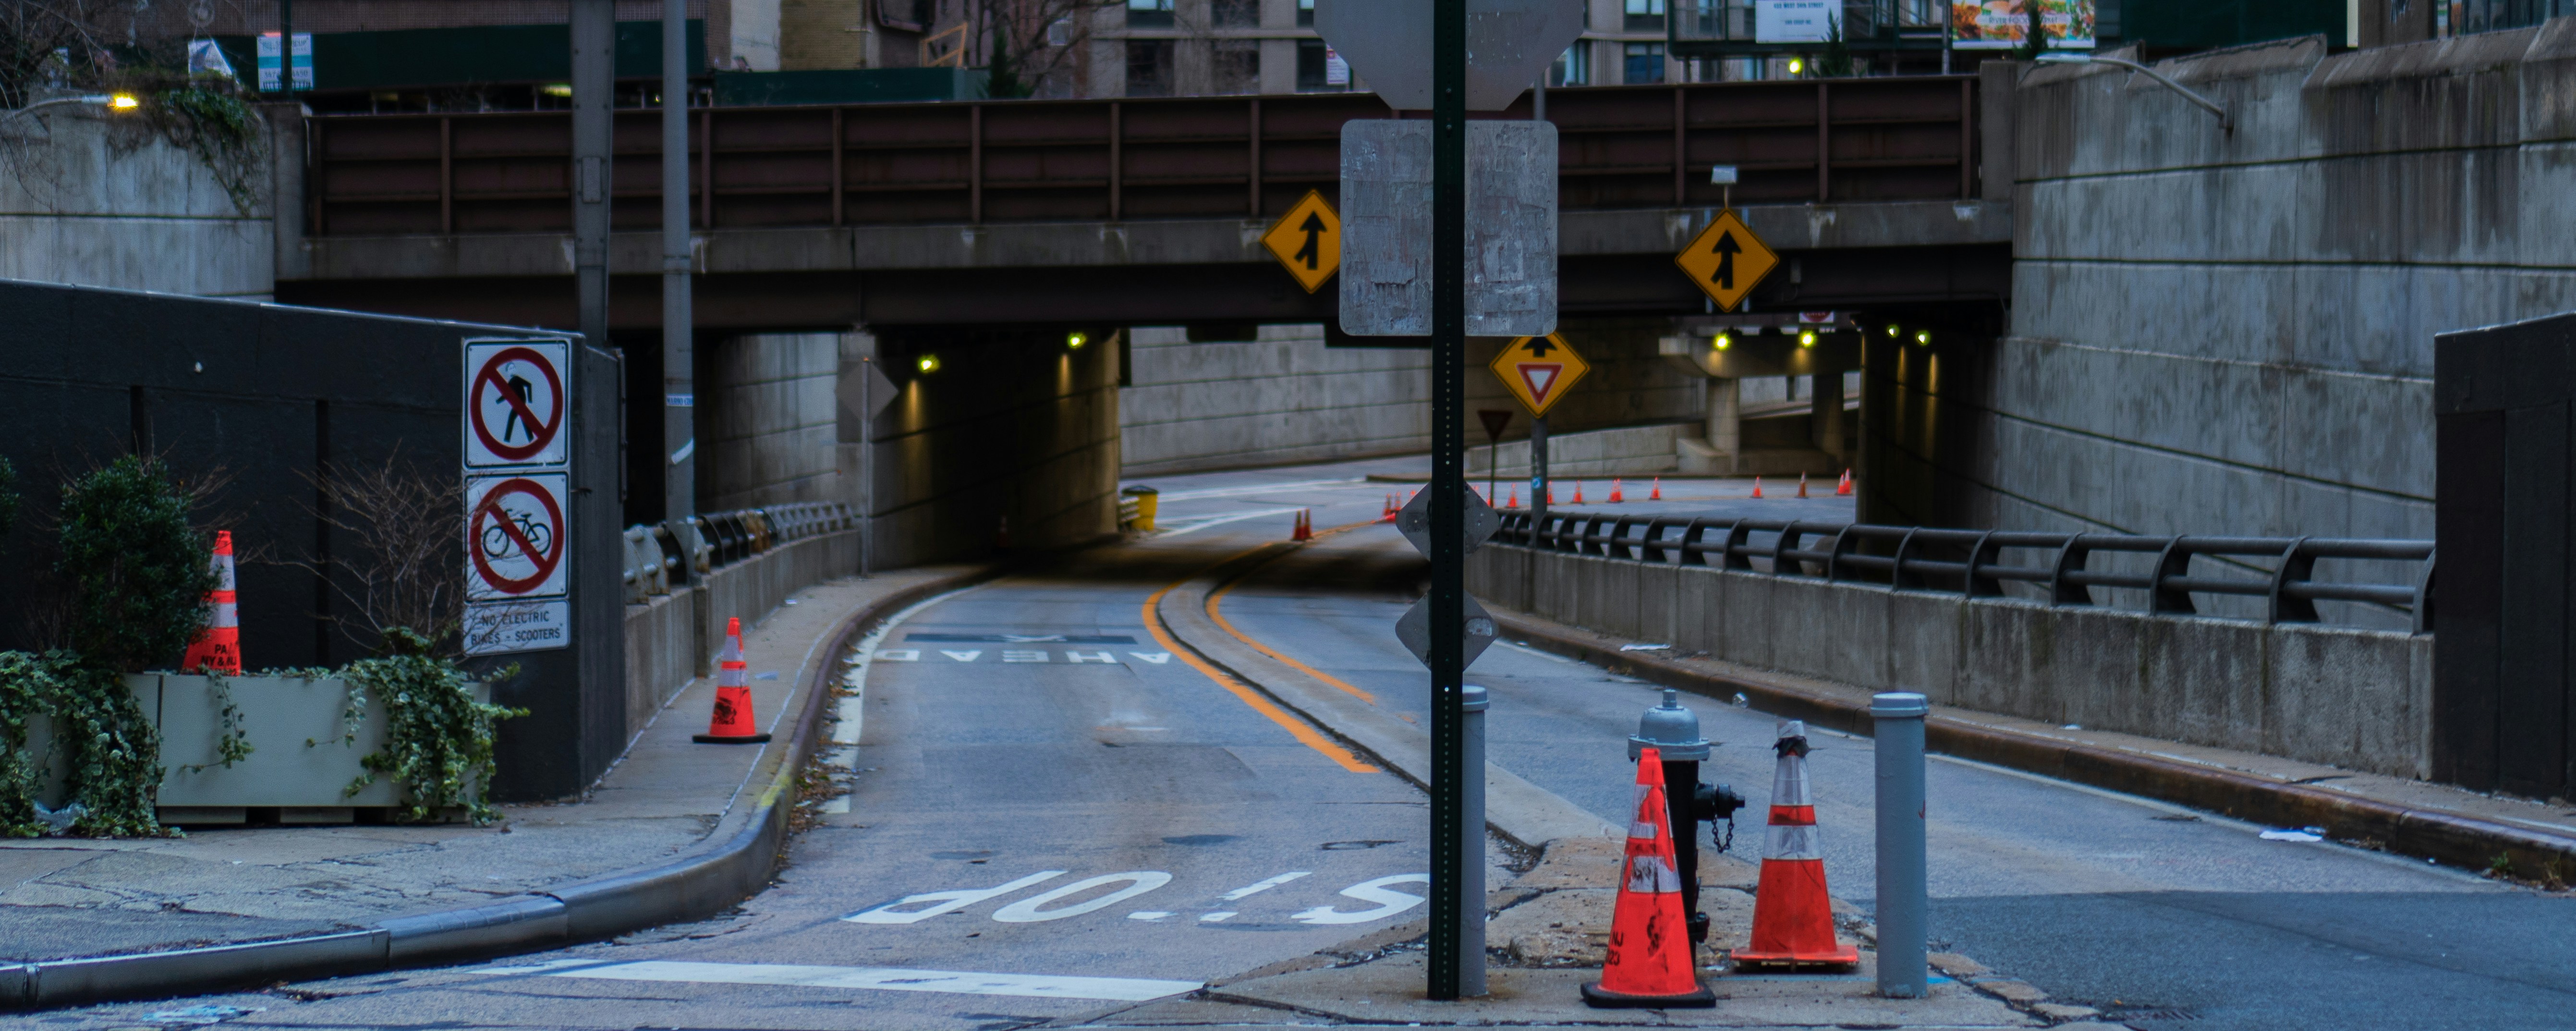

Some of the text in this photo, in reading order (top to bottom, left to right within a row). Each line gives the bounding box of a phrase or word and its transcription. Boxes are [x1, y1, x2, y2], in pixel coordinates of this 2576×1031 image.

[482, 610, 550, 626] NO ELECTRIC
[471, 632, 500, 646] BIKES
[515, 628, 561, 642] SCOOTERS
[215, 644, 227, 654] PA
[872, 649, 1172, 664] AHEAD
[201, 655, 216, 667] NY
